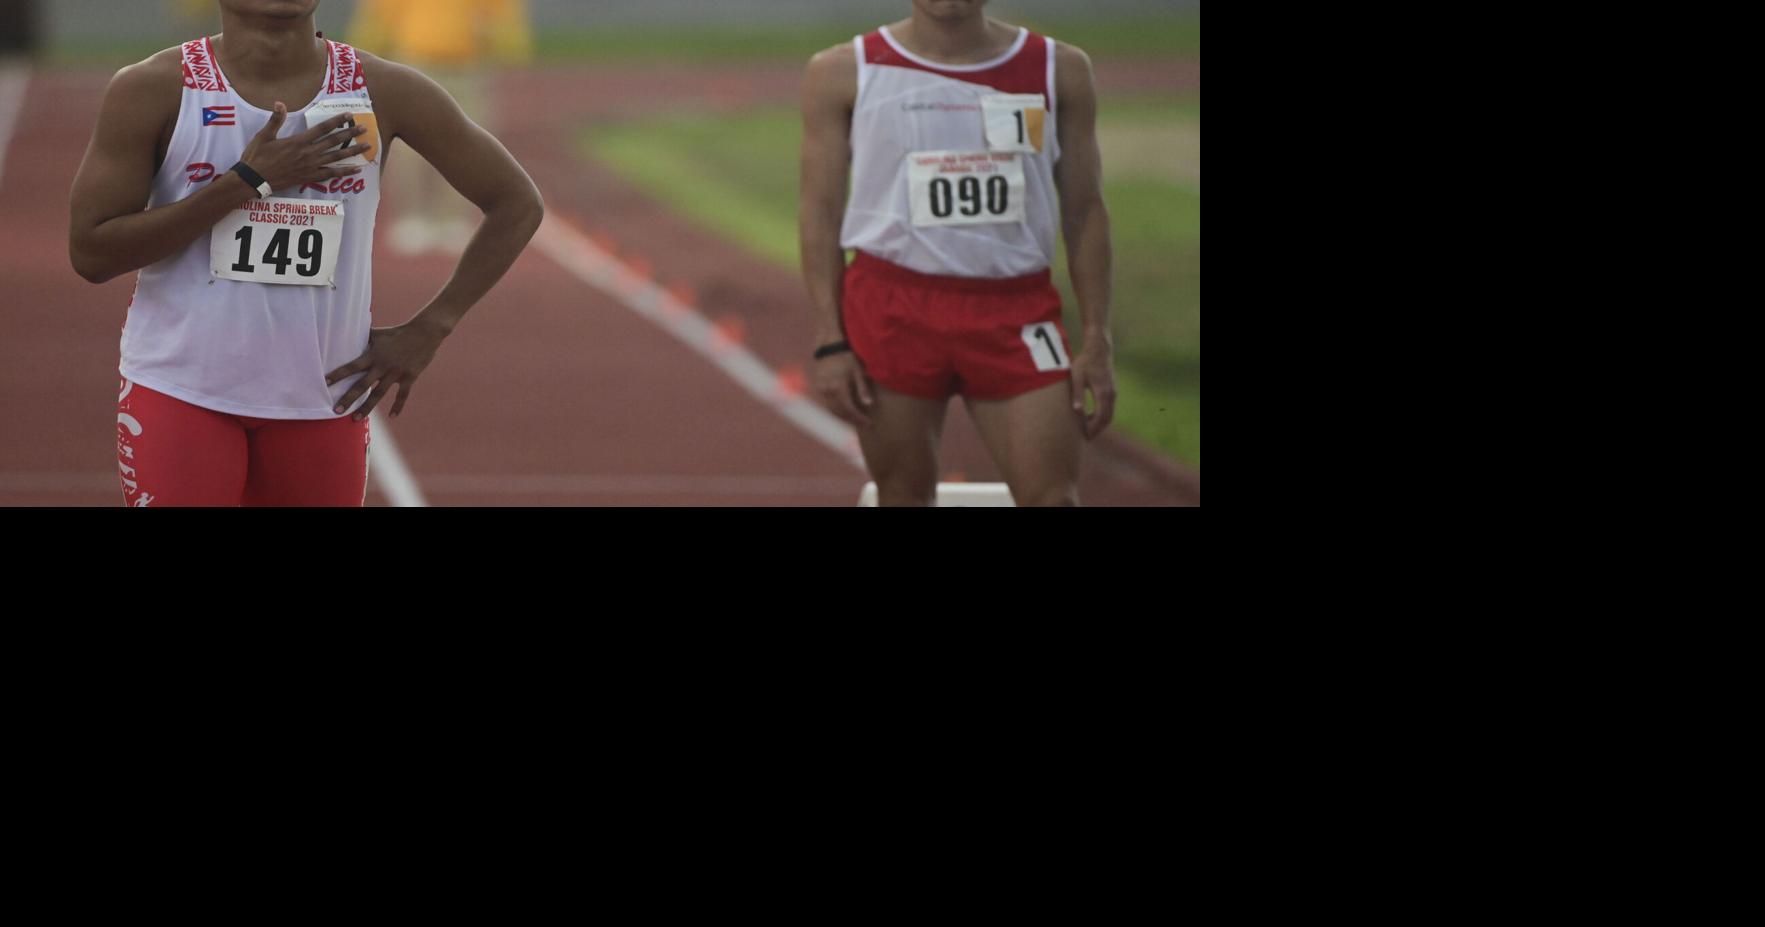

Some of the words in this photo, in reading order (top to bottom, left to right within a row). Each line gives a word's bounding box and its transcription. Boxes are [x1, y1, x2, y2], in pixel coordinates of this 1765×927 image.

[1012, 110, 1024, 143] 1
[240, 200, 271, 212] OLINA
[273, 202, 307, 214] SPRING
[309, 205, 338, 215] BREAK
[930, 175, 1008, 217] 090
[249, 212, 289, 224] CLASSIC
[290, 214, 315, 226] 2021
[231, 225, 324, 277] 149
[1034, 325, 1061, 365] 1
